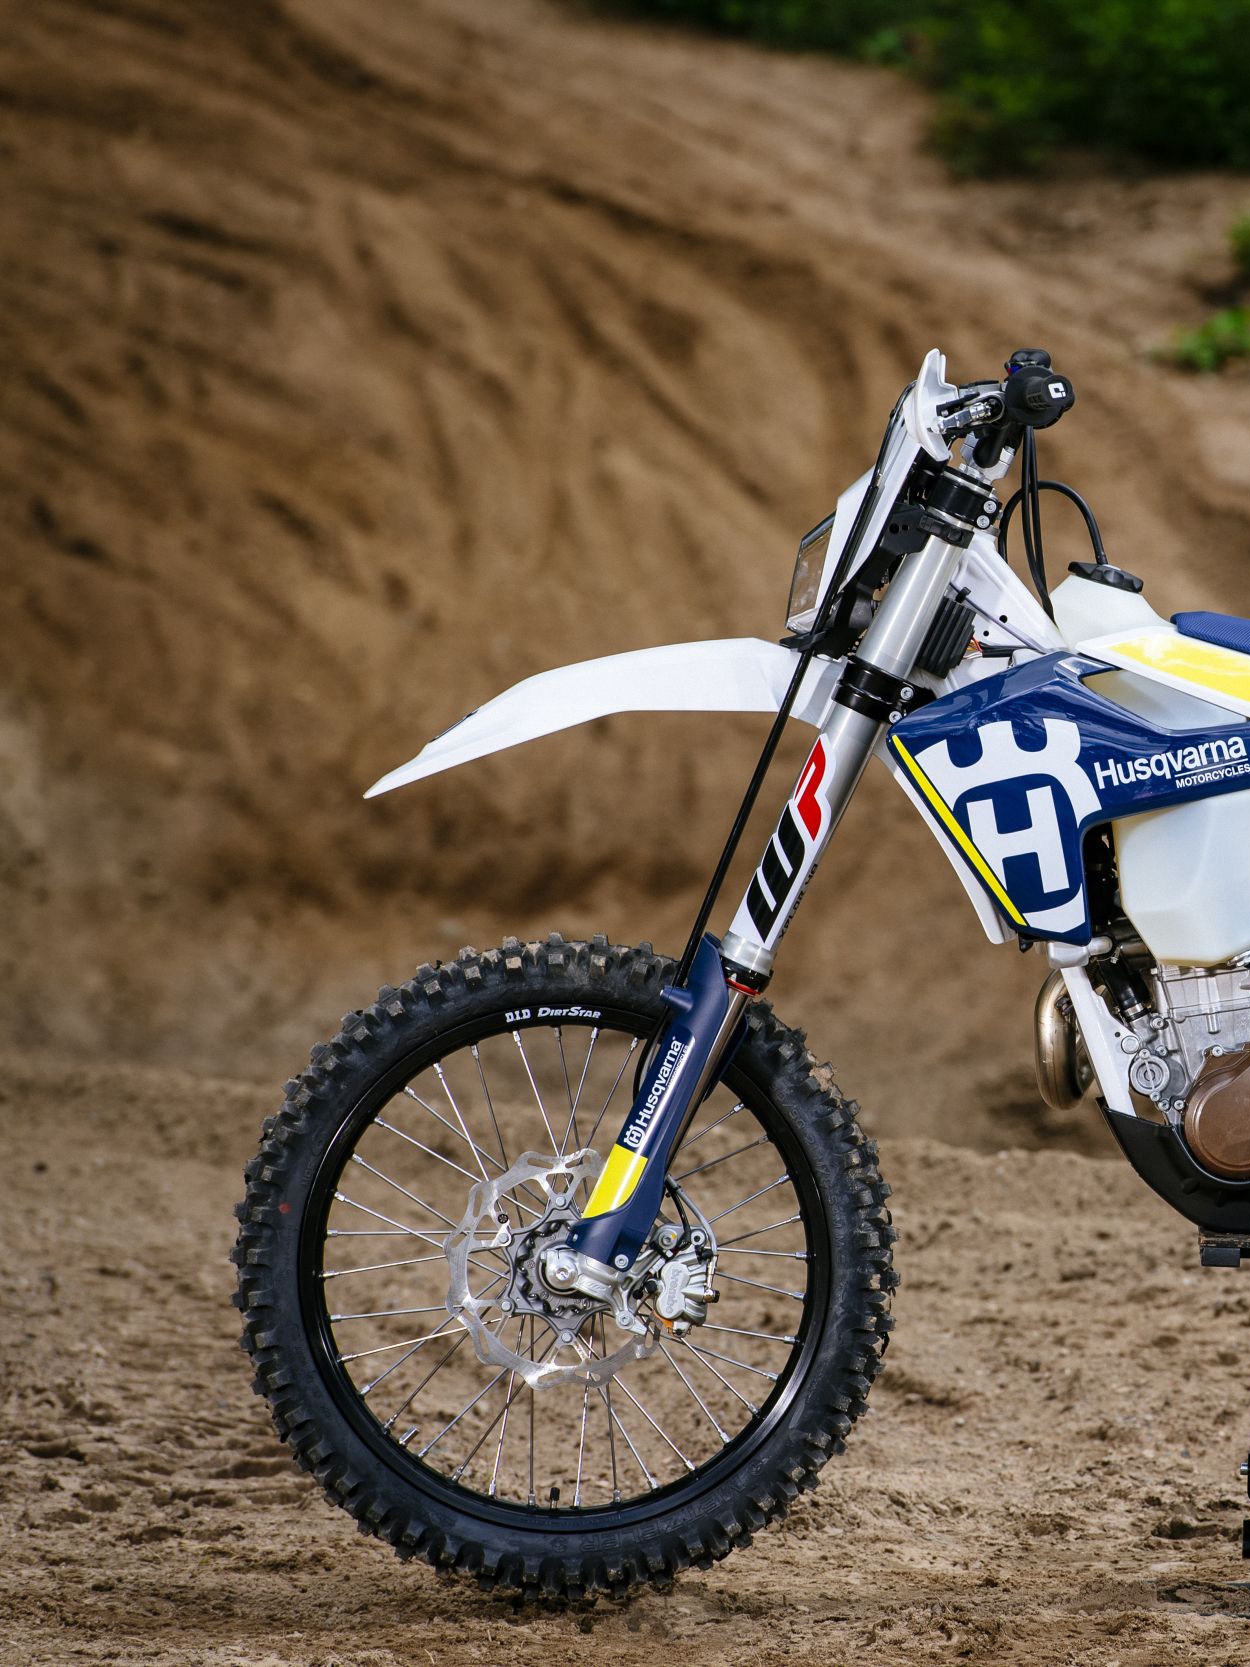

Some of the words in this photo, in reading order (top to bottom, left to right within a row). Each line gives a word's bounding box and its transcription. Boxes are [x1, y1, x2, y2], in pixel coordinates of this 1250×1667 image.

[1093, 736, 1247, 790] Husqvarna
[746, 737, 826, 944] WP
[636, 1038, 682, 1128] Husqvarna
